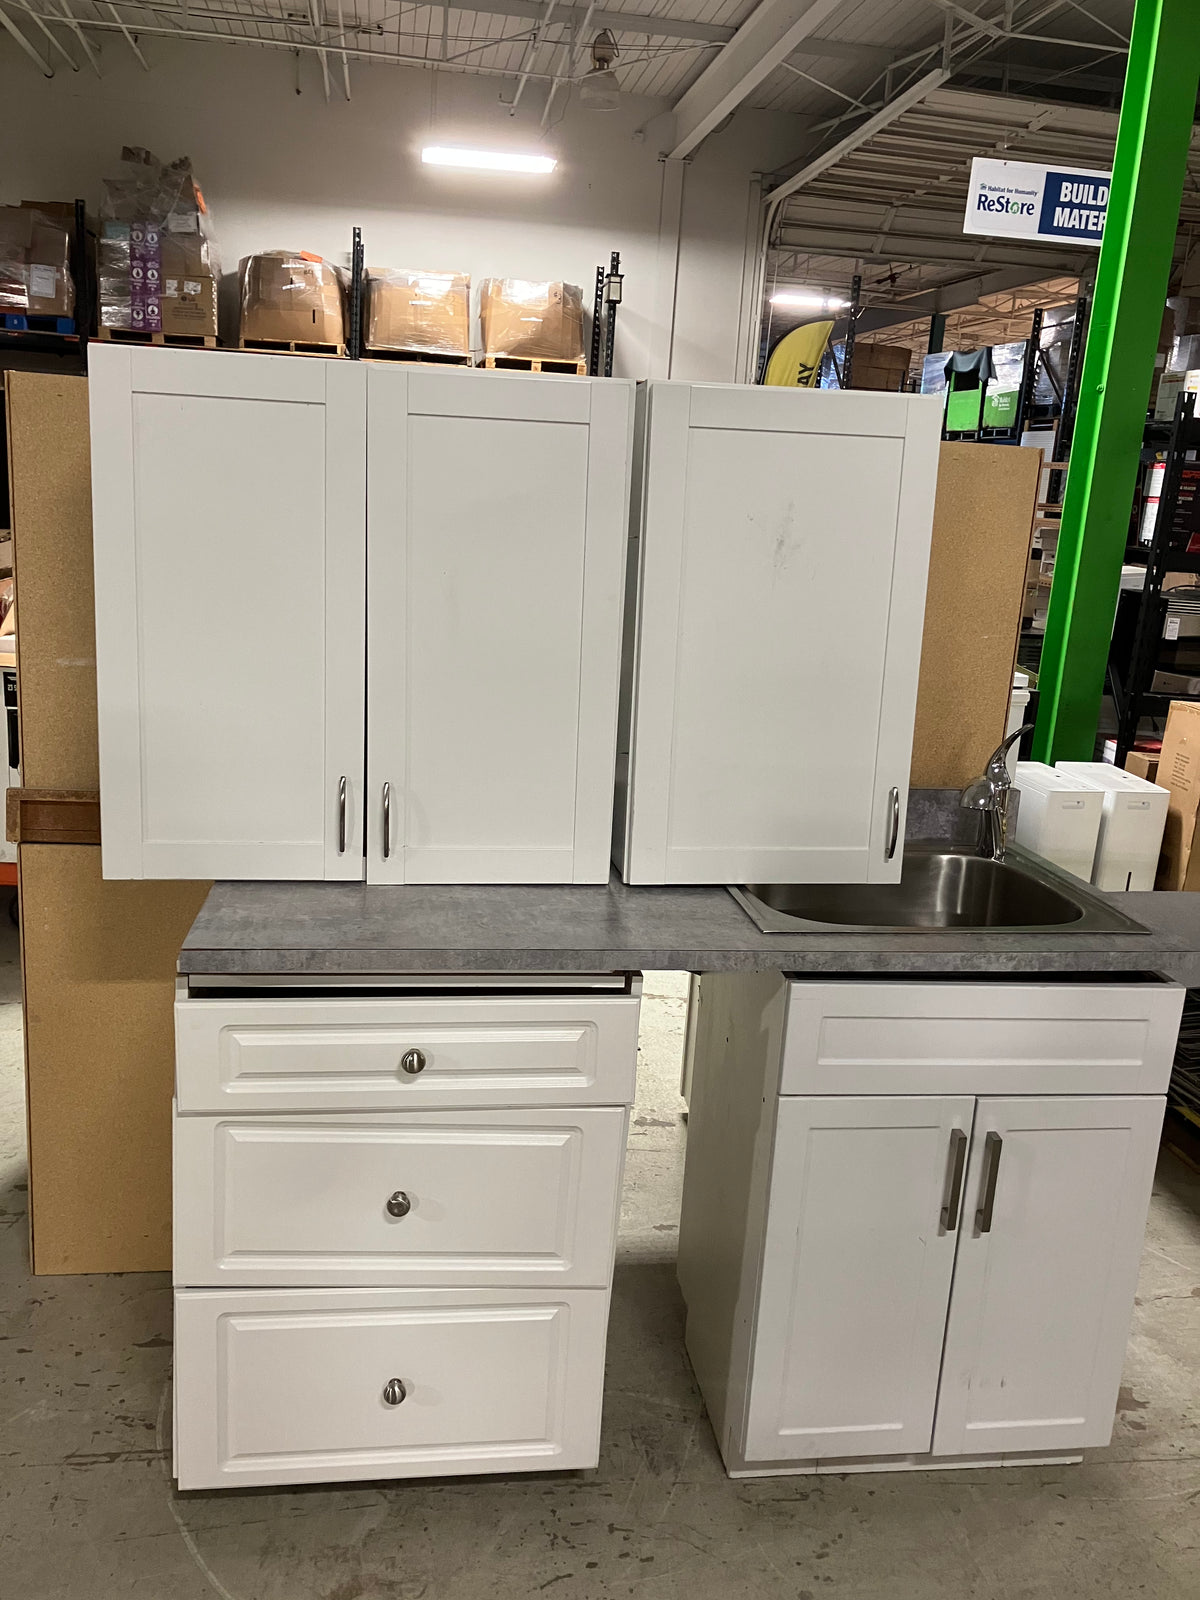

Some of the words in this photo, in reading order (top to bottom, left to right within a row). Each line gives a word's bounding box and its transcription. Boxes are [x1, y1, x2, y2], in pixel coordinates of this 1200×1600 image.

[987, 185, 1006, 193] Habitat
[1014, 188, 1038, 197] Humanity
[1060, 181, 1109, 206] BUILD
[977, 193, 1035, 216] ReStore
